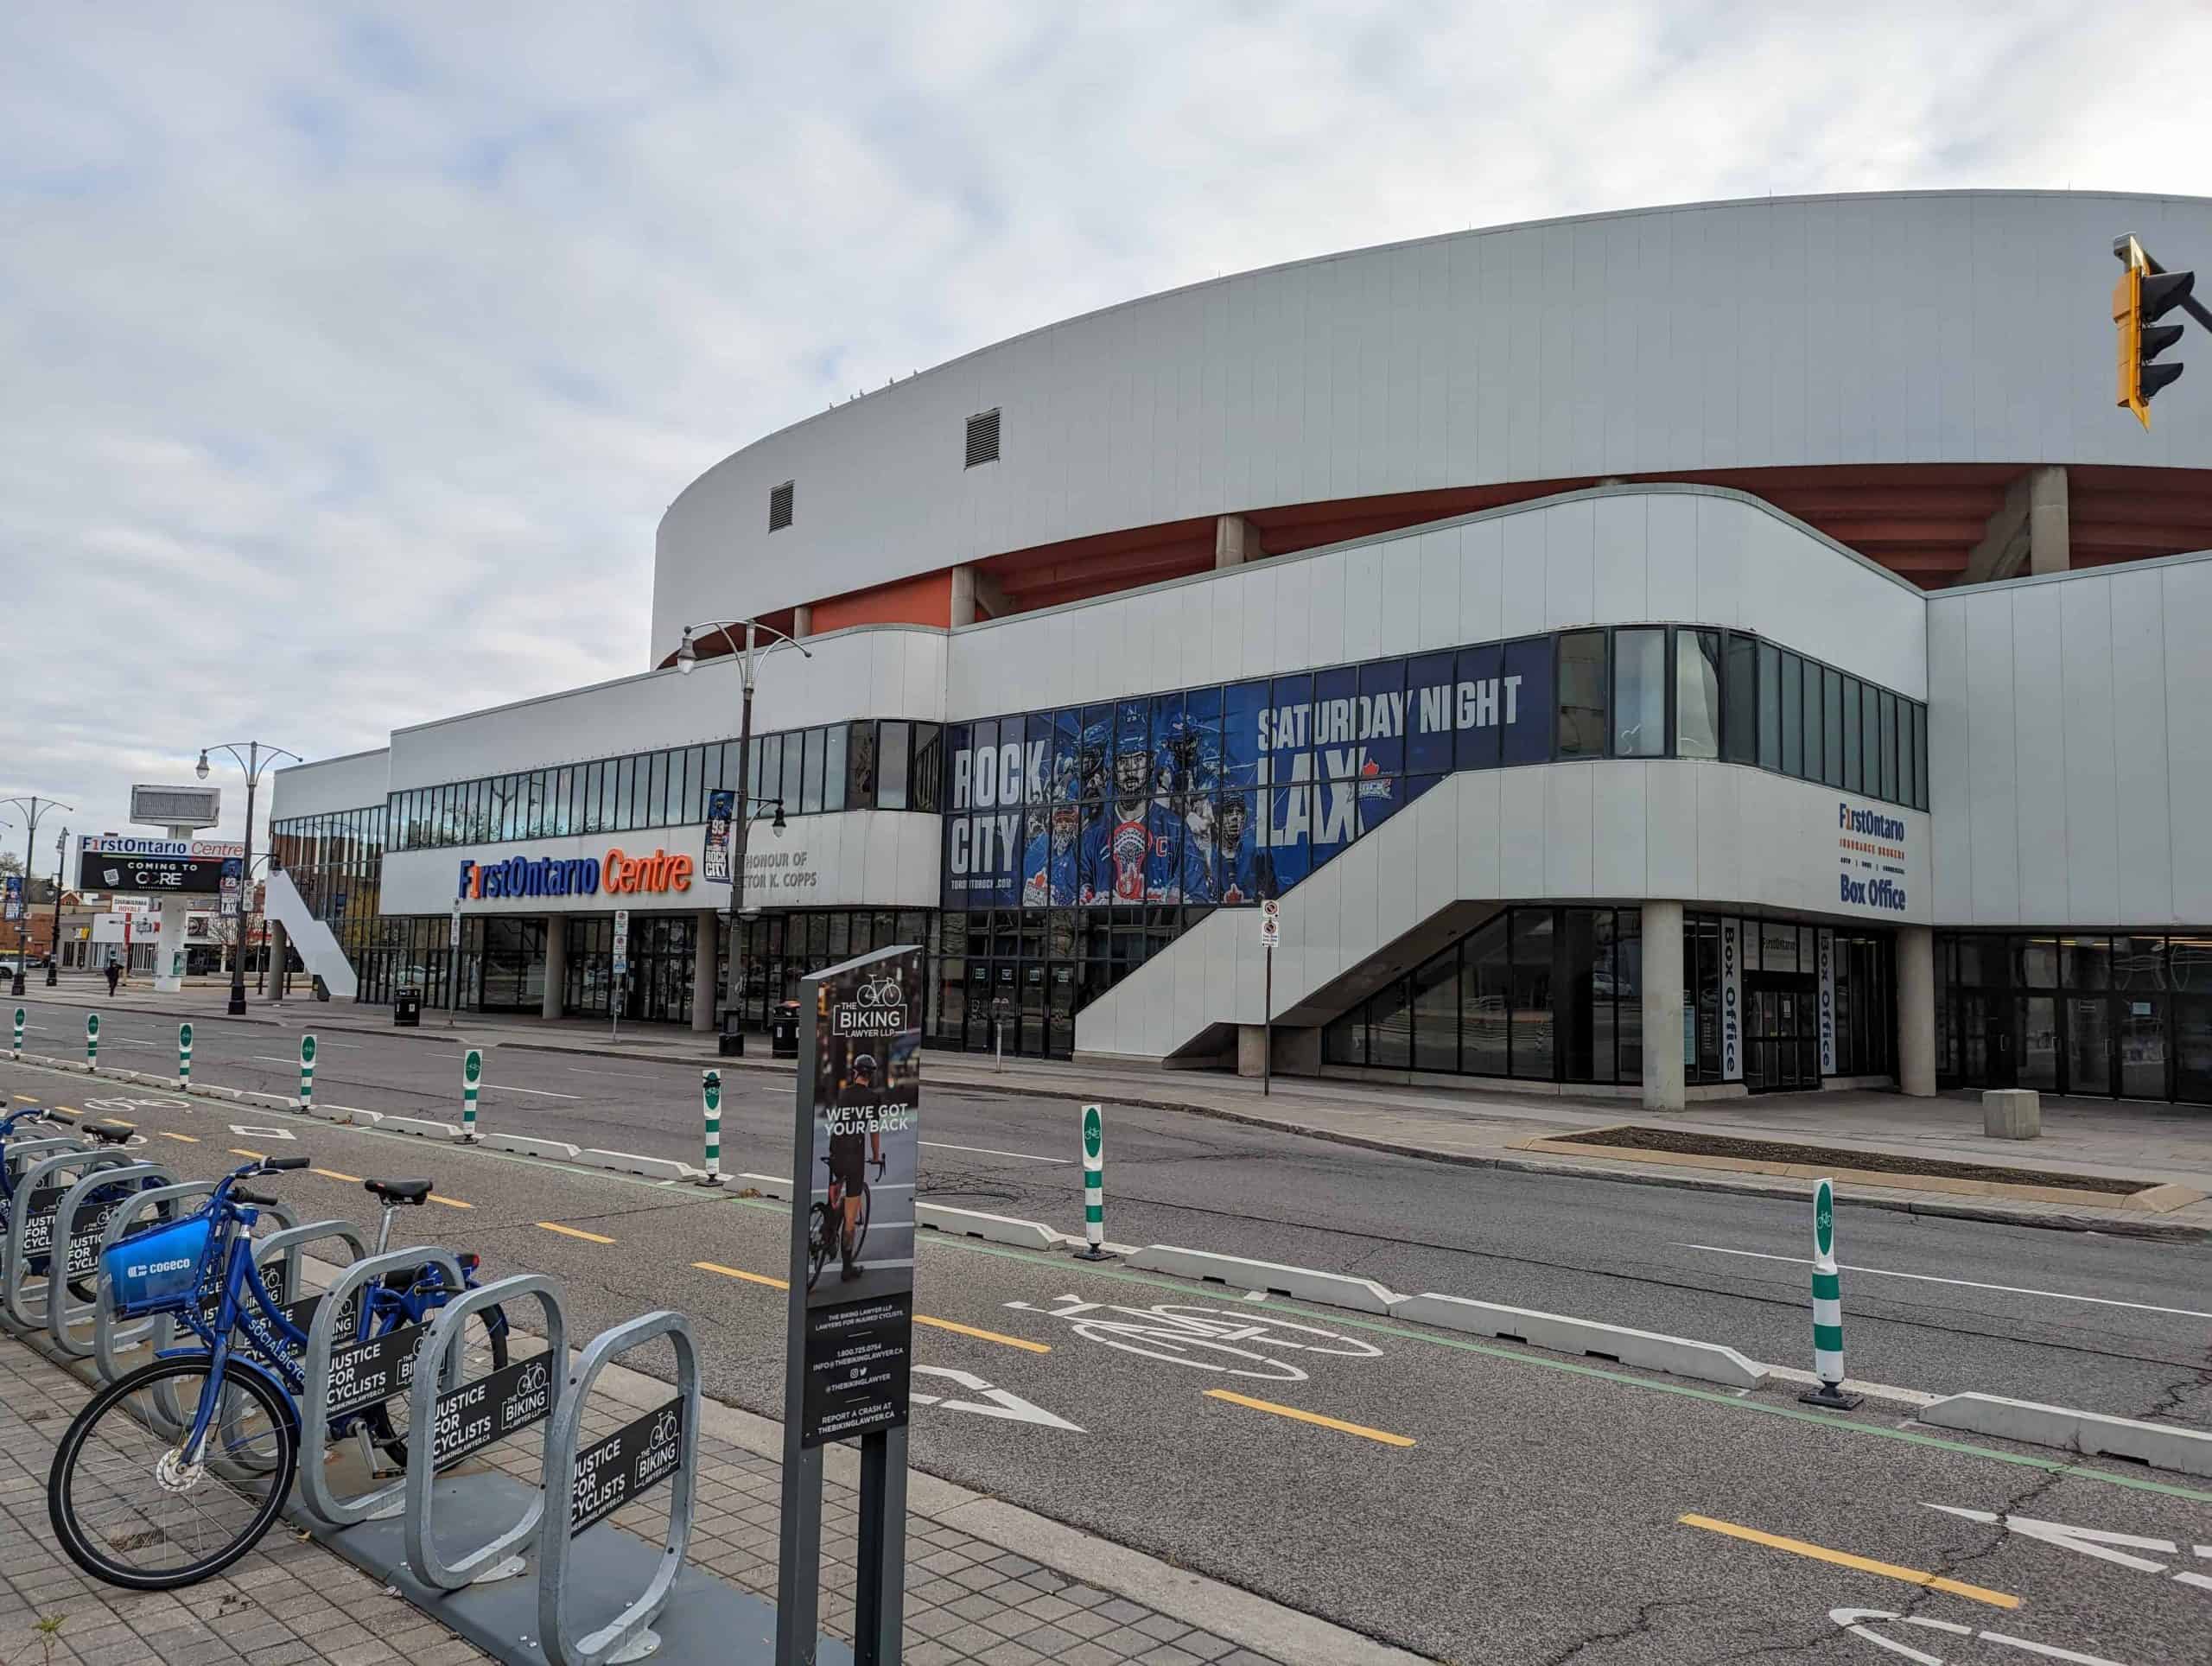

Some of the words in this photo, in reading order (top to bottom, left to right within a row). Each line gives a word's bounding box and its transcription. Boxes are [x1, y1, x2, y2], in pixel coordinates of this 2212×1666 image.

[1258, 690, 1414, 751] SATURDAY
[1420, 675, 1522, 734] NIGHT
[954, 741, 1045, 808] ROCK
[1256, 746, 1367, 848] LAX
[712, 820, 725, 834] 93
[191, 842, 244, 856] Centre
[951, 814, 1020, 874] CITY
[1156, 836, 1168, 857] C
[127, 862, 176, 870] COMING
[705, 851, 727, 862] ROCK
[746, 853, 789, 868] HONOUR
[793, 852, 807, 866] OF
[135, 871, 183, 886] CORE
[602, 848, 693, 893] Centre
[705, 862, 727, 877] CITY
[783, 872, 817, 887] COPPS
[1840, 873, 1866, 905] Box
[1868, 879, 1906, 911] Office
[1725, 926, 1735, 978] Box
[1821, 936, 1830, 982] Box
[841, 1002, 857, 1010] THE
[840, 1011, 900, 1028] BIKING
[1821, 990, 1832, 1066] Office
[845, 1028, 879, 1038] LAWYER
[880, 1028, 895, 1037] LLP
[1726, 987, 1738, 1072] Office
[825, 1105, 874, 1122] WE'VE
[878, 1103, 908, 1117] GOT
[824, 1121, 866, 1136] YOUR
[869, 1119, 909, 1133] BACK
[26, 1215, 55, 1228] JUSTI
[24, 1227, 48, 1238] FOR
[69, 1233, 104, 1250] JUSTIC
[23, 1236, 52, 1250] CYCL
[67, 1256, 99, 1271] CYCLI
[68, 1247, 91, 1261] FOR
[860, 1306, 882, 1315] LAWYER
[815, 1320, 842, 1332] LAWYERS
[328, 1343, 381, 1373] JUSTICE
[403, 1353, 413, 1363] THE
[327, 1367, 355, 1389] FOR
[327, 1371, 386, 1404] CYCLISTS
[435, 1383, 486, 1421] JUSTICE
[505, 1390, 545, 1421] BIKING
[507, 1394, 518, 1404] THE
[510, 1413, 532, 1428] LAWYER
[531, 1408, 542, 1418] LLP
[817, 1410, 895, 1435] THEBIKINGLAWYER.CA
[822, 1411, 850, 1425] REPORT
[851, 1409, 858, 1418] A
[858, 1404, 882, 1415] CRASH
[882, 1402, 893, 1410] AT
[435, 1413, 460, 1434] FOR
[433, 1415, 492, 1455] CYCLISTS
[573, 1438, 621, 1480] JUSTICE
[639, 1442, 676, 1478] BIKING
[641, 1447, 651, 1459] THE
[641, 1467, 663, 1486] LAWYER
[571, 1473, 626, 1522] CYCLISTS
